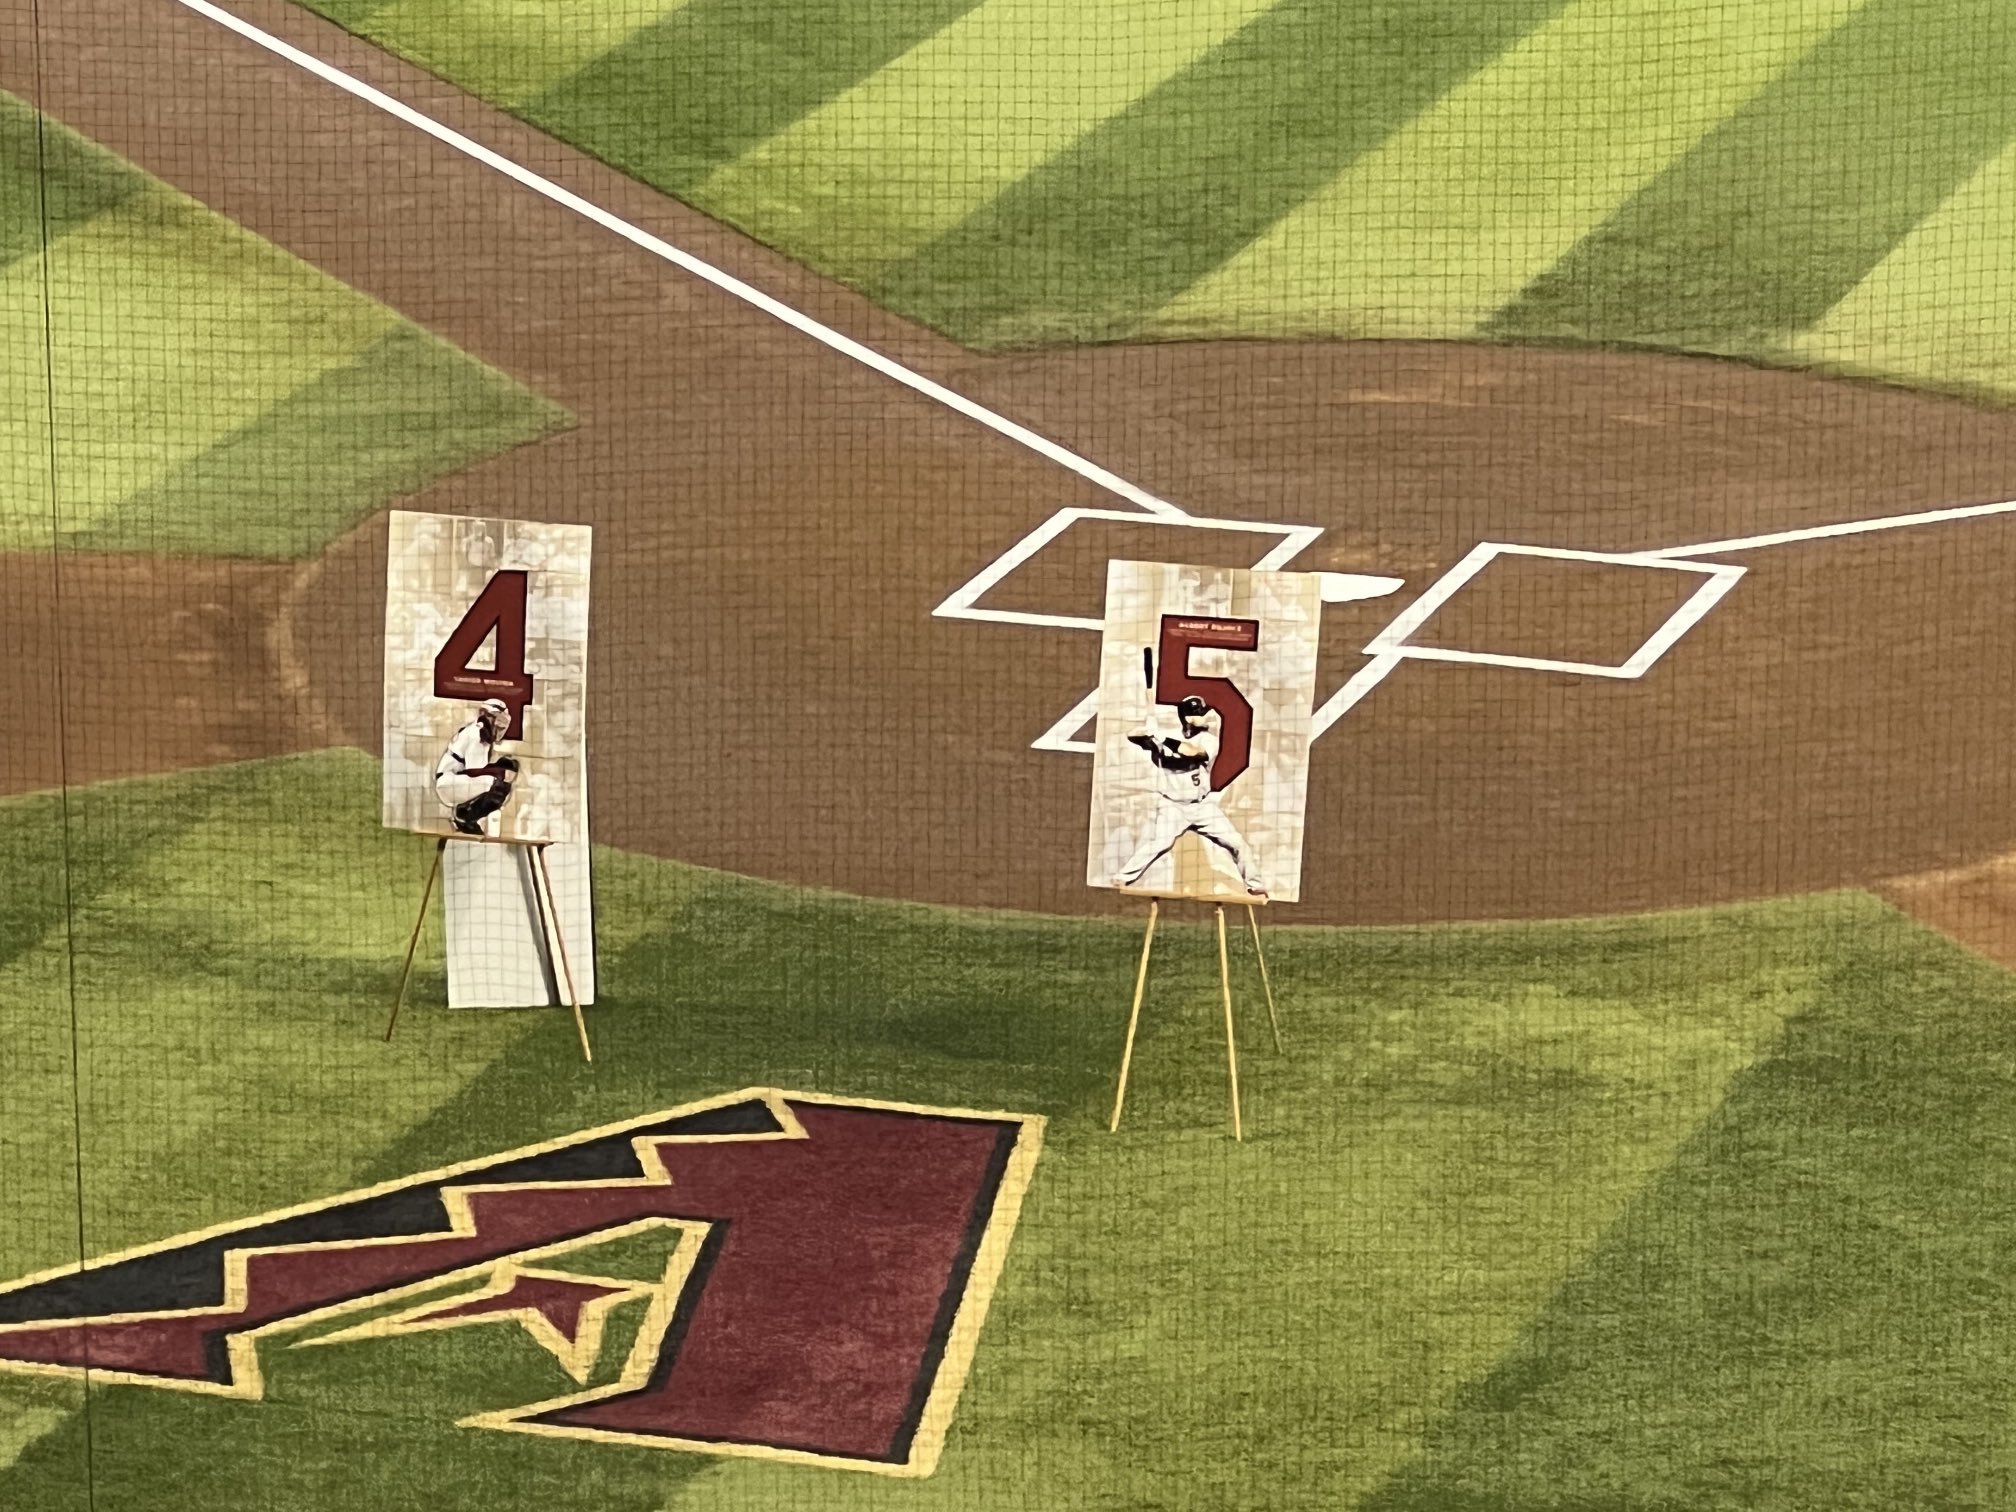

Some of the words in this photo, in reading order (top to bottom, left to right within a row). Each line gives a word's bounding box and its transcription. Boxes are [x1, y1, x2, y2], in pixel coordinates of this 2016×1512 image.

[434, 569, 534, 741] 4
[1155, 614, 1260, 792] 5
[1191, 773, 1201, 787] 5
